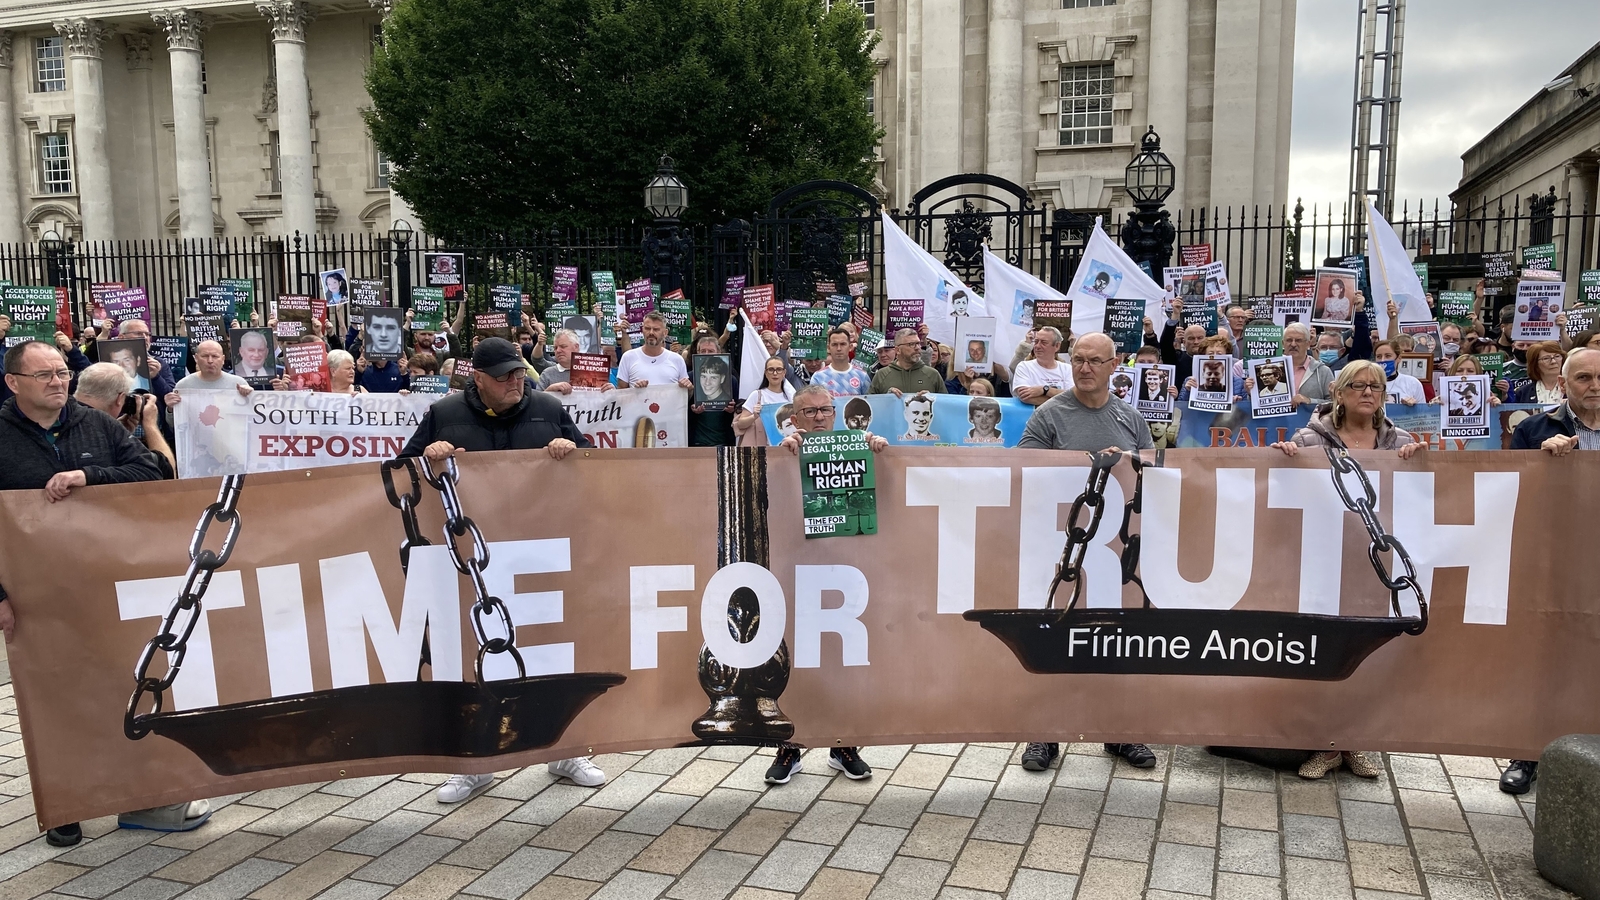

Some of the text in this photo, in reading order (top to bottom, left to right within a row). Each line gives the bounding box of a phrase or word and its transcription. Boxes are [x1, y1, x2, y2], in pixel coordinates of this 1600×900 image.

[1485, 260, 1512, 268] BRITISH
[1527, 257, 1552, 265] HUMAN
[117, 289, 142, 297] FAMILIES
[1109, 314, 1139, 322] HUMAN
[1194, 402, 1228, 410] INNOCENT
[1257, 407, 1292, 415] INNOCENT
[349, 405, 428, 427] BELFA
[562, 401, 622, 425] Truth
[803, 437, 835, 446] ACCESS
[1209, 426, 1300, 448] BALL
[803, 443, 869, 454] LEGAL PROCESS
[809, 461, 866, 477] HUMAN
[816, 474, 861, 489] RIGHT
[809, 525, 834, 533] TRUTH
[114, 467, 1520, 713] TIME FOR TRUTH
[1067, 627, 1318, 665] Fírinne Anois!
